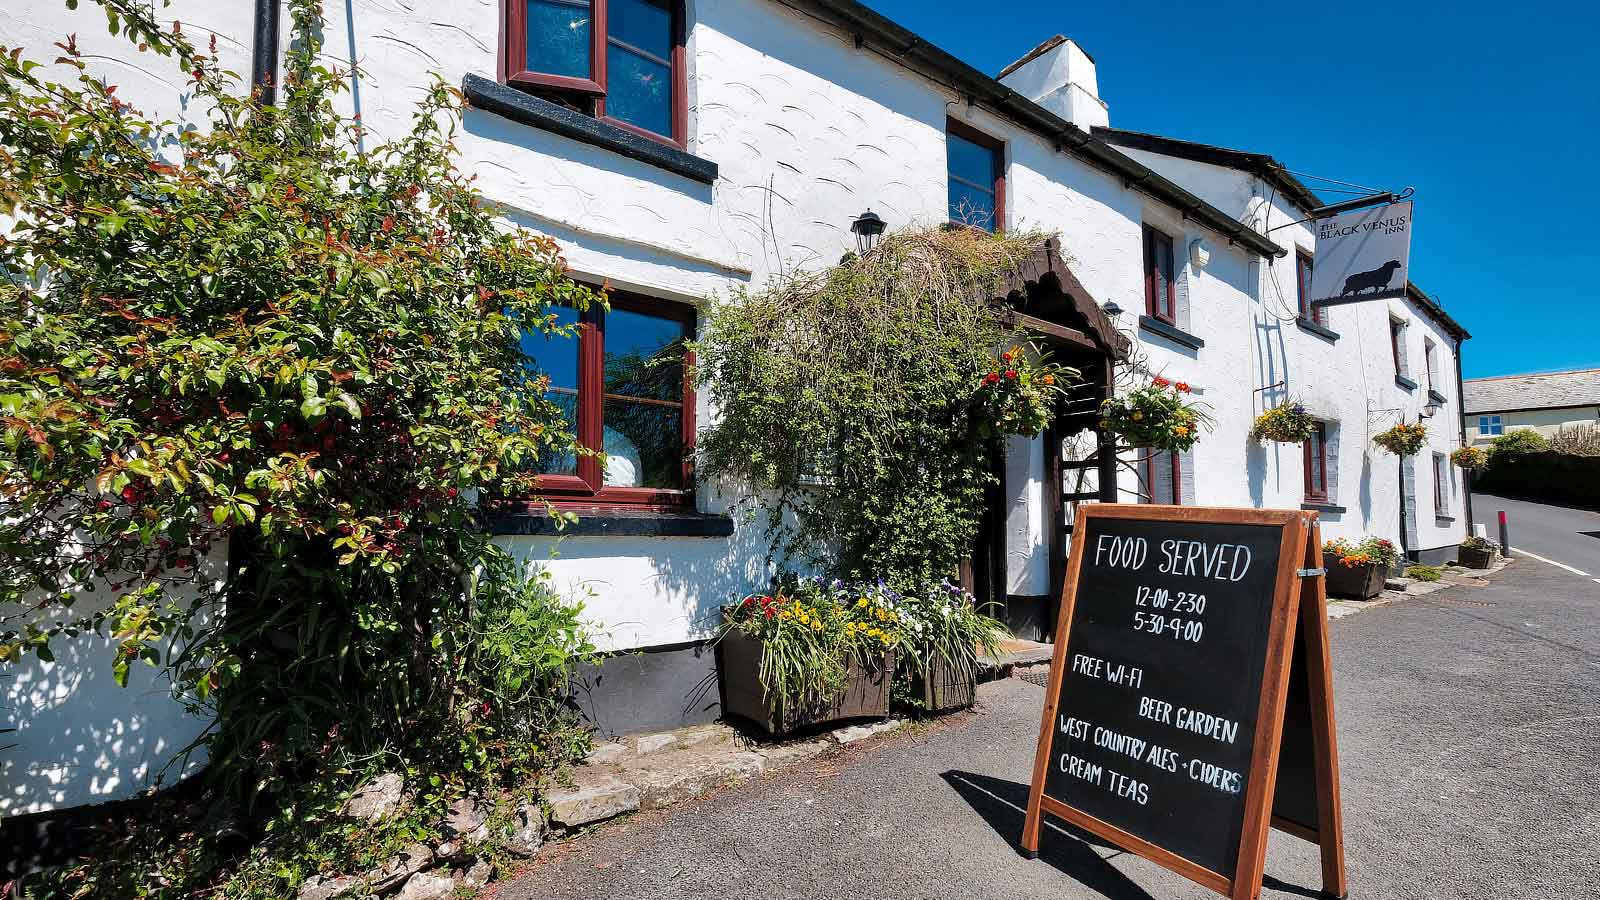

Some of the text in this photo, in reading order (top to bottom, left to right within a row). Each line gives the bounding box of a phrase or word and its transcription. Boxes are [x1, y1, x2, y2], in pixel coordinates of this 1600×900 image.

[1320, 223, 1337, 231] THE
[1320, 216, 1406, 240] BLACK VENUS
[1385, 225, 1405, 235] INN
[1095, 535, 1251, 581] FOOD SERVED
[1072, 654, 1143, 688] FREE WI-FI
[1138, 696, 1239, 744] BEER GARDEN
[1060, 714, 1092, 742] WEST
[1094, 726, 1146, 761] COUNTRY
[1146, 744, 1179, 773] ALES
[1189, 759, 1243, 793] CIDERS
[1060, 753, 1149, 805] CREAM TEAS
